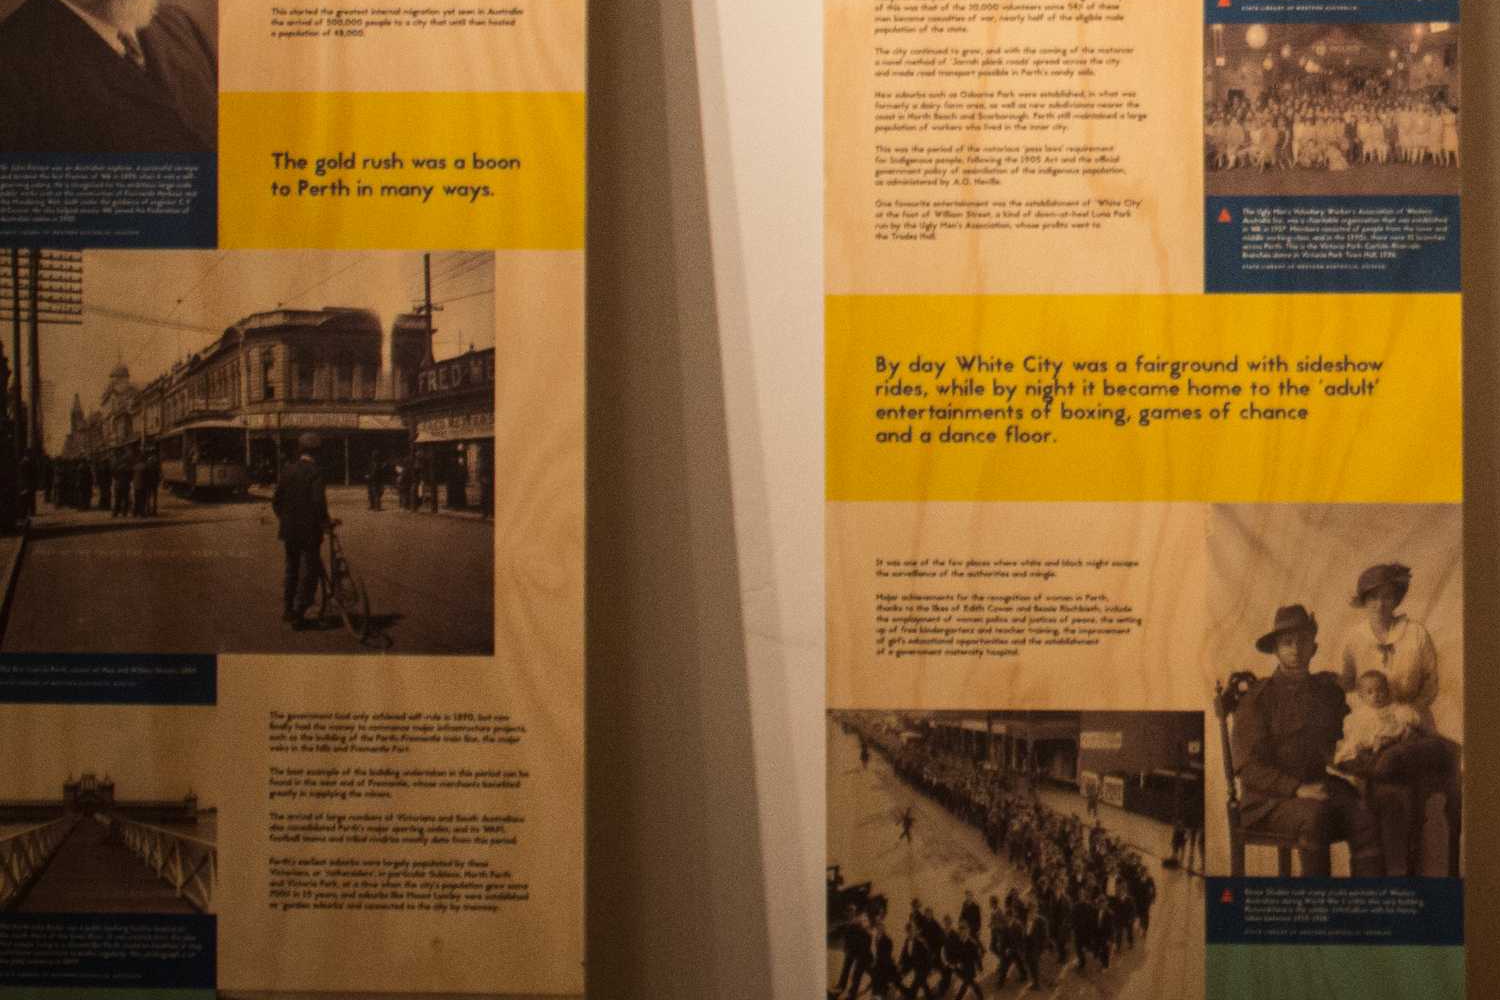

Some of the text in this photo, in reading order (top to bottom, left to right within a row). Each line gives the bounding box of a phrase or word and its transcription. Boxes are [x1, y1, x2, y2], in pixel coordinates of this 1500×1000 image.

[270, 150, 521, 175] The gold rush was a boon
[270, 177, 494, 203] to Perth in many ways.
[875, 353, 1383, 380] By day White City was a fairground with sideshow
[875, 377, 928, 398] rides,
[935, 377, 985, 397] while
[992, 377, 1017, 402] by
[1024, 376, 1075, 402] night
[1082, 378, 1095, 396] it
[1102, 378, 1180, 397] became
[1186, 377, 1242, 396] home
[1249, 381, 1270, 396] to
[1277, 377, 1310, 396] the
[875, 400, 1308, 426] entertainments of boxing, games of chance
[875, 424, 1056, 444] and a dance floor.
